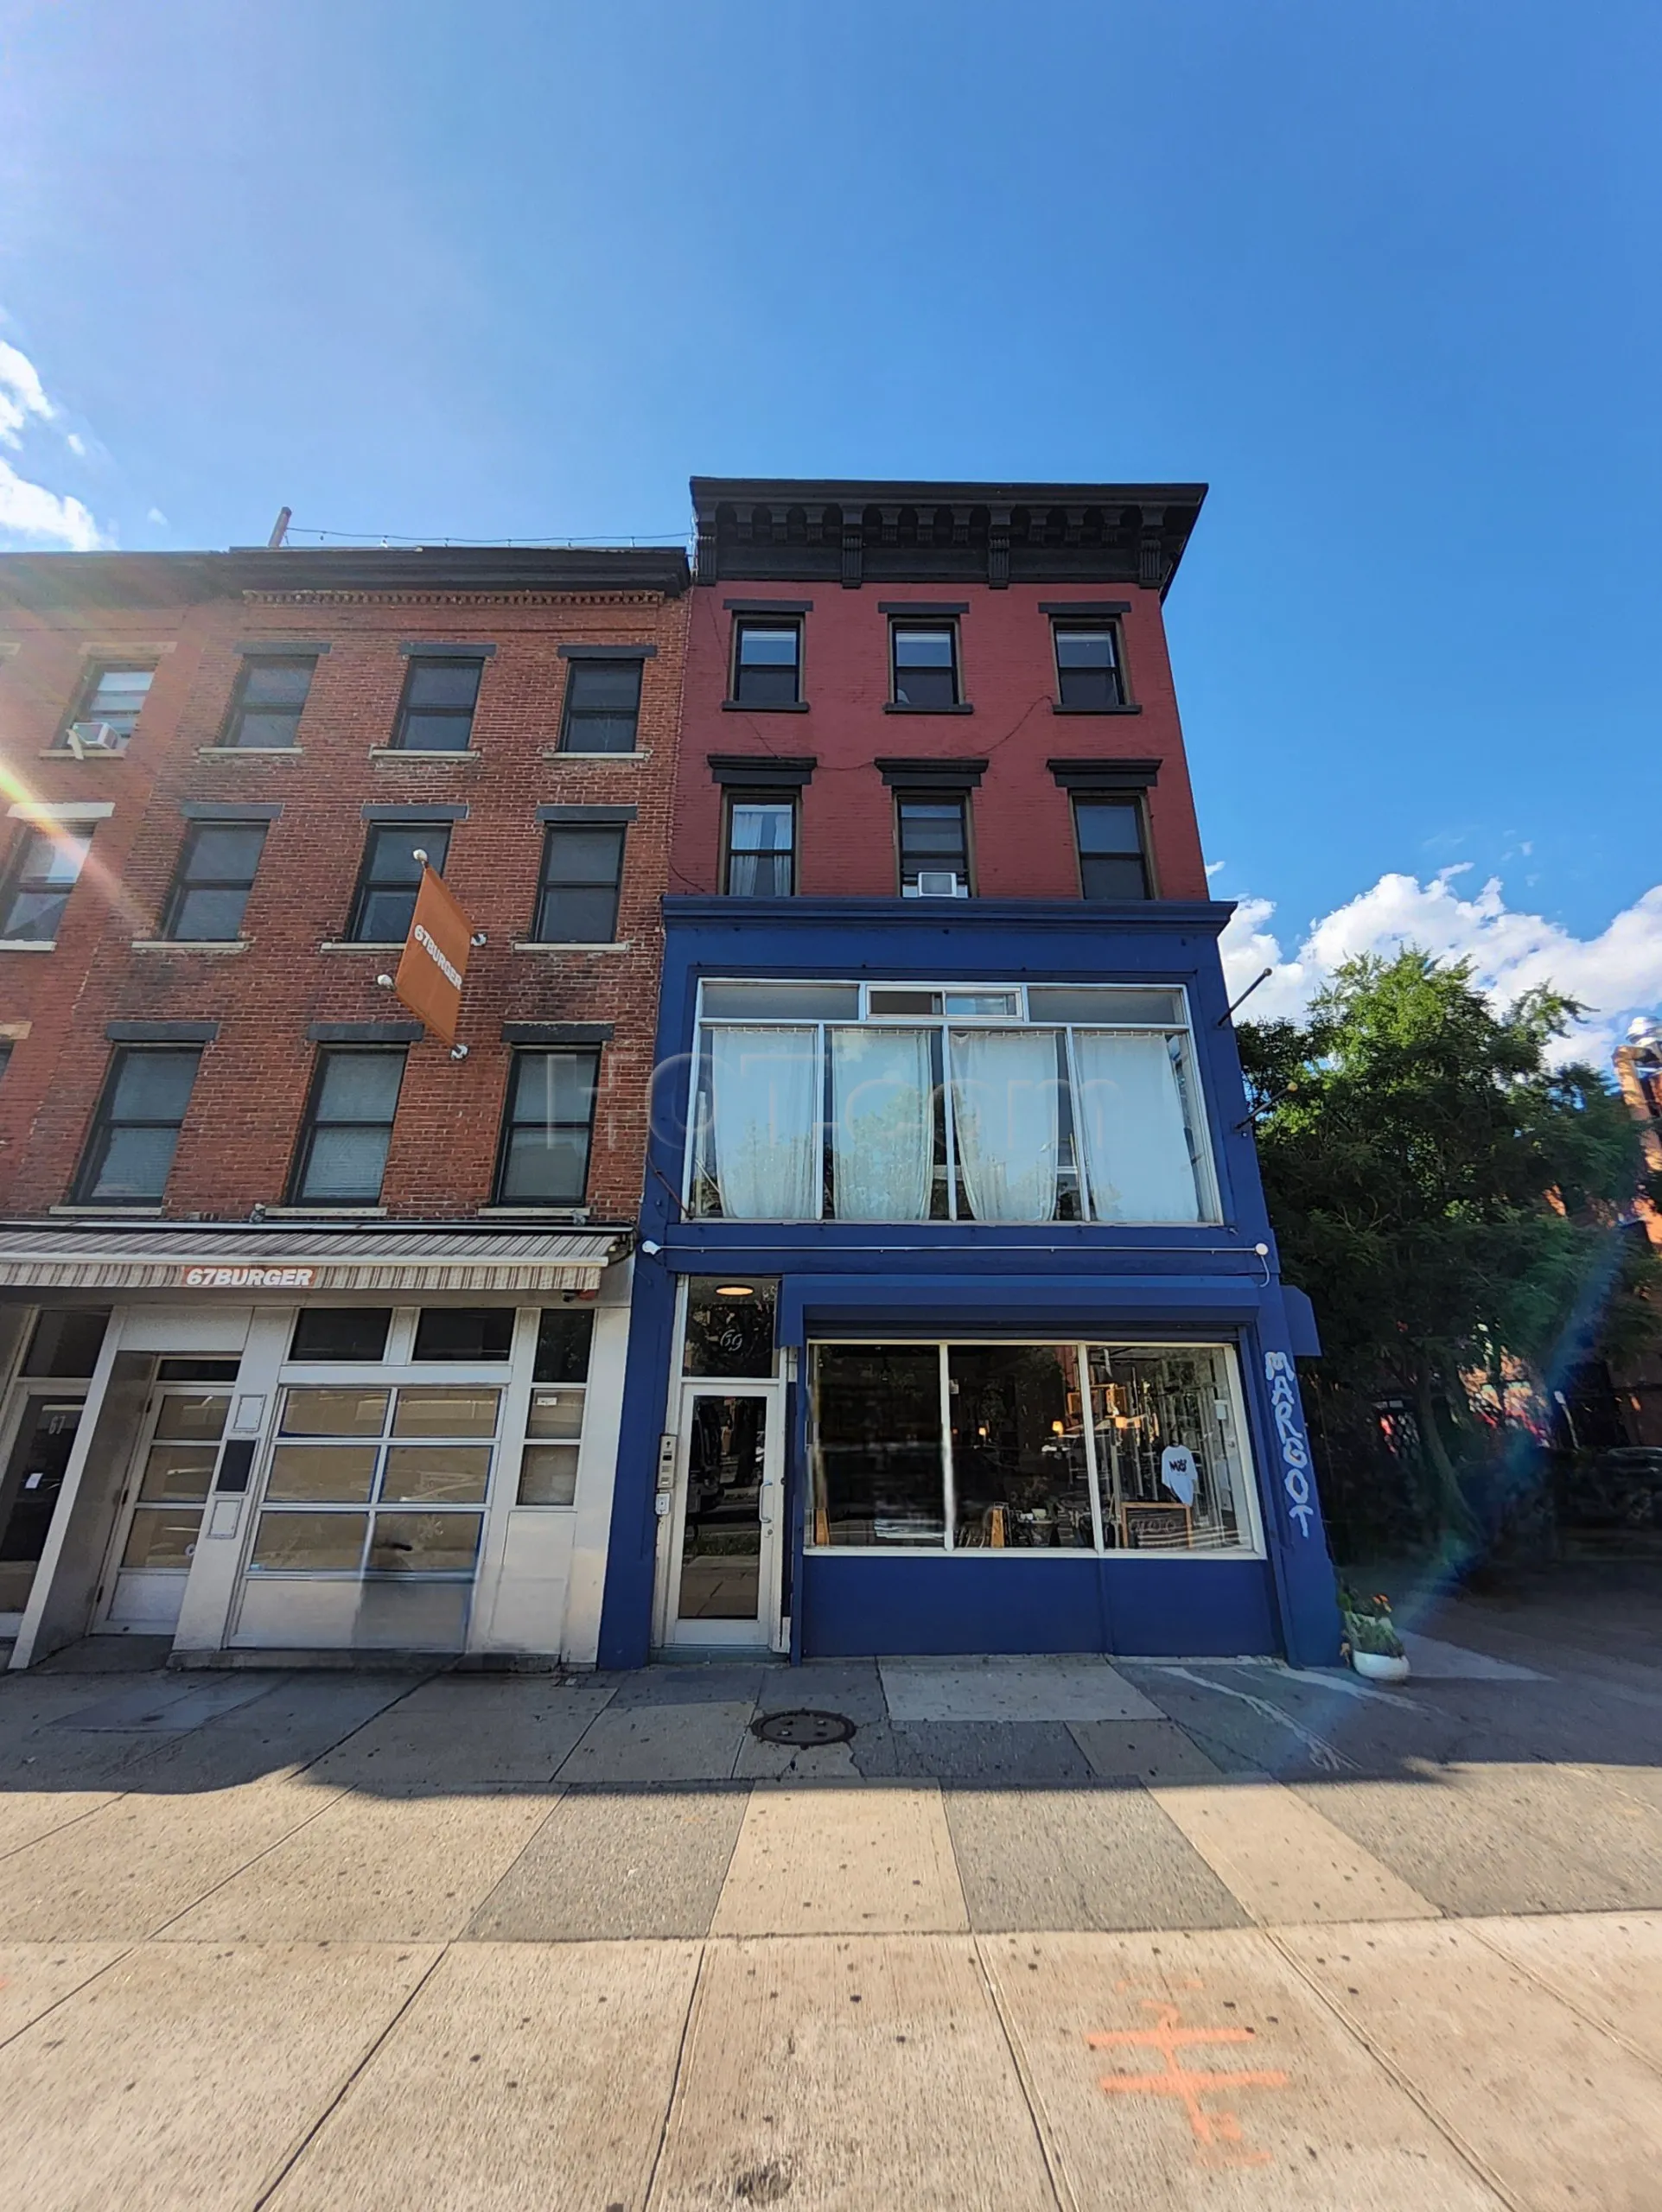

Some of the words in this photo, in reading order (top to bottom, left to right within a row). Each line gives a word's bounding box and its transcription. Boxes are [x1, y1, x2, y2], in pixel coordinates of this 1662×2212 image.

[414, 925, 463, 991] 67BURGER
[186, 1268, 314, 1286] 67BURGER
[720, 1329, 742, 1351] 69
[48, 1415, 67, 1434] 67
[1264, 1351, 1314, 1539] MARGOT
